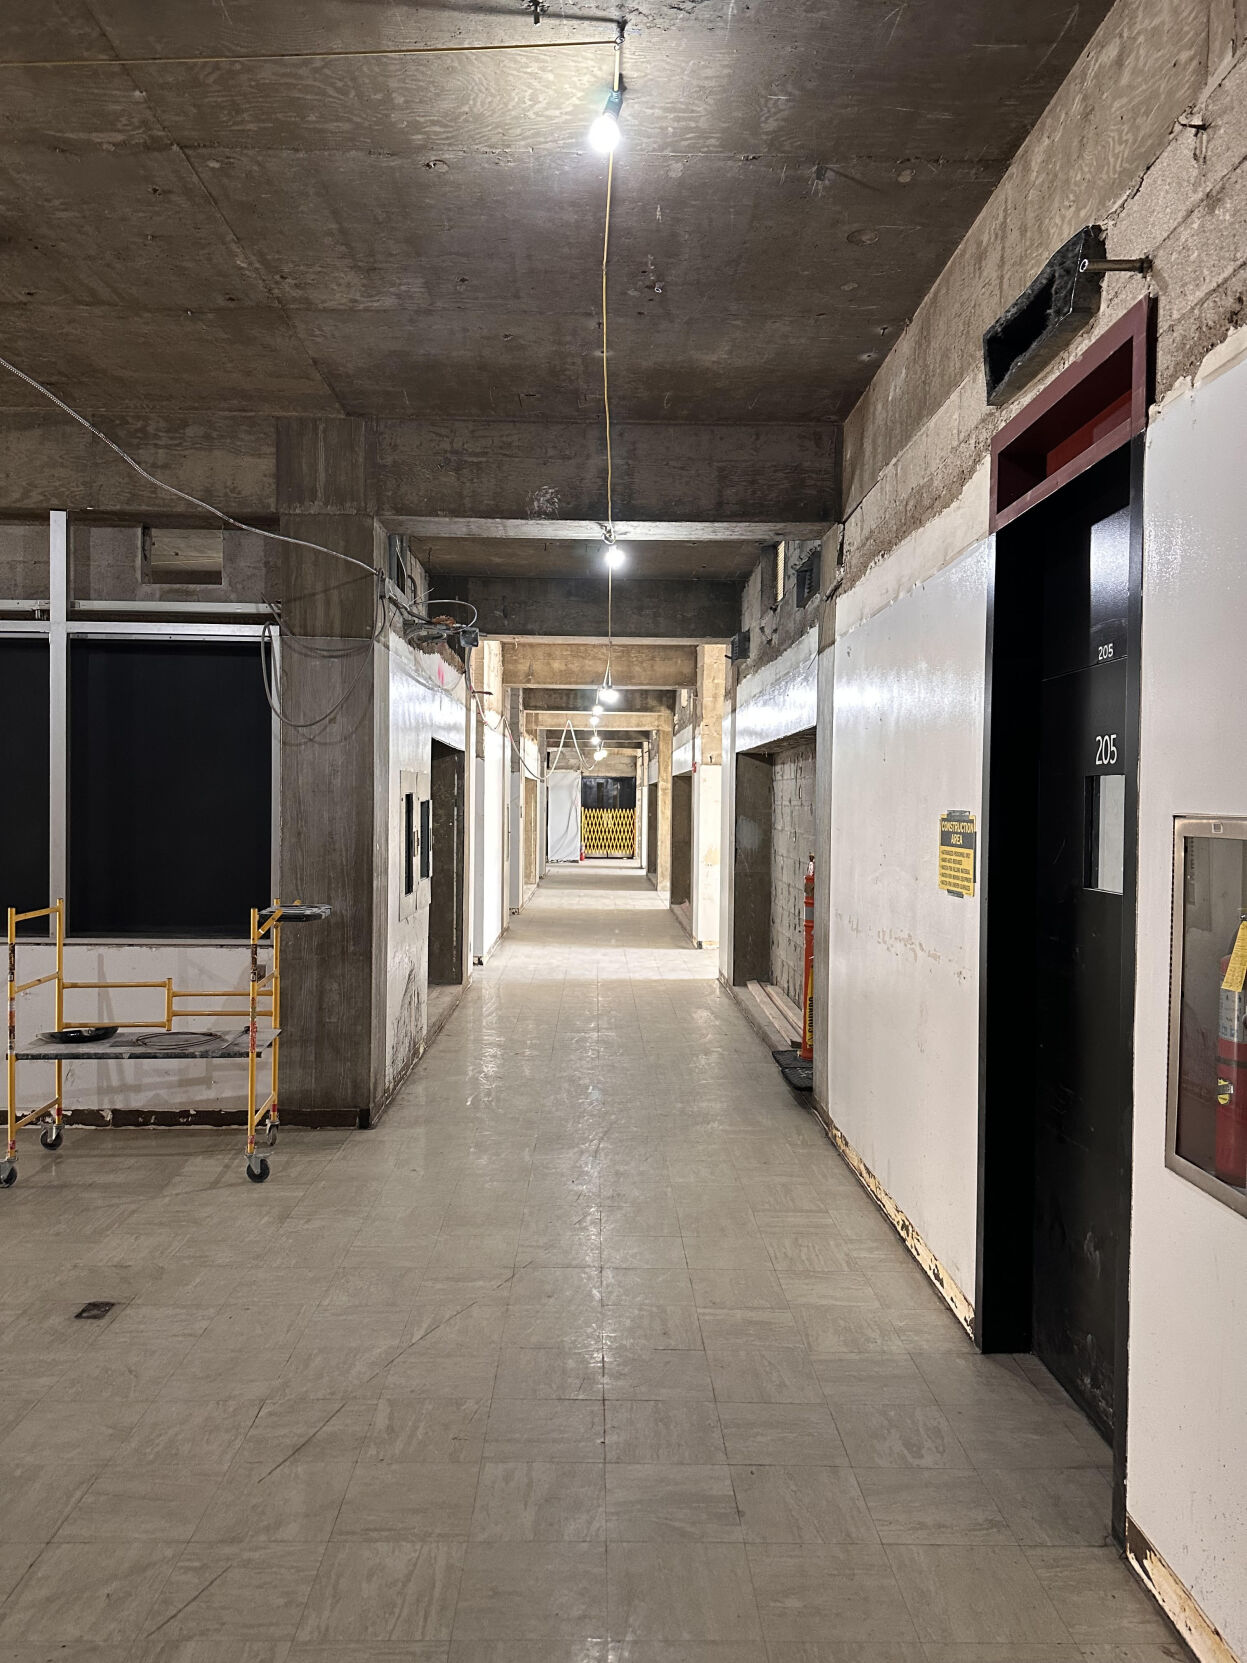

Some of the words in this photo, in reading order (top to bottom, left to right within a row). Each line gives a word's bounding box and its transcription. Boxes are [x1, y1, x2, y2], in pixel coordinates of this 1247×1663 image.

[1098, 643, 1114, 660] 205
[1095, 734, 1117, 765] 205
[942, 822, 974, 834] CONSTRUCTION
[951, 834, 963, 845] AREA
